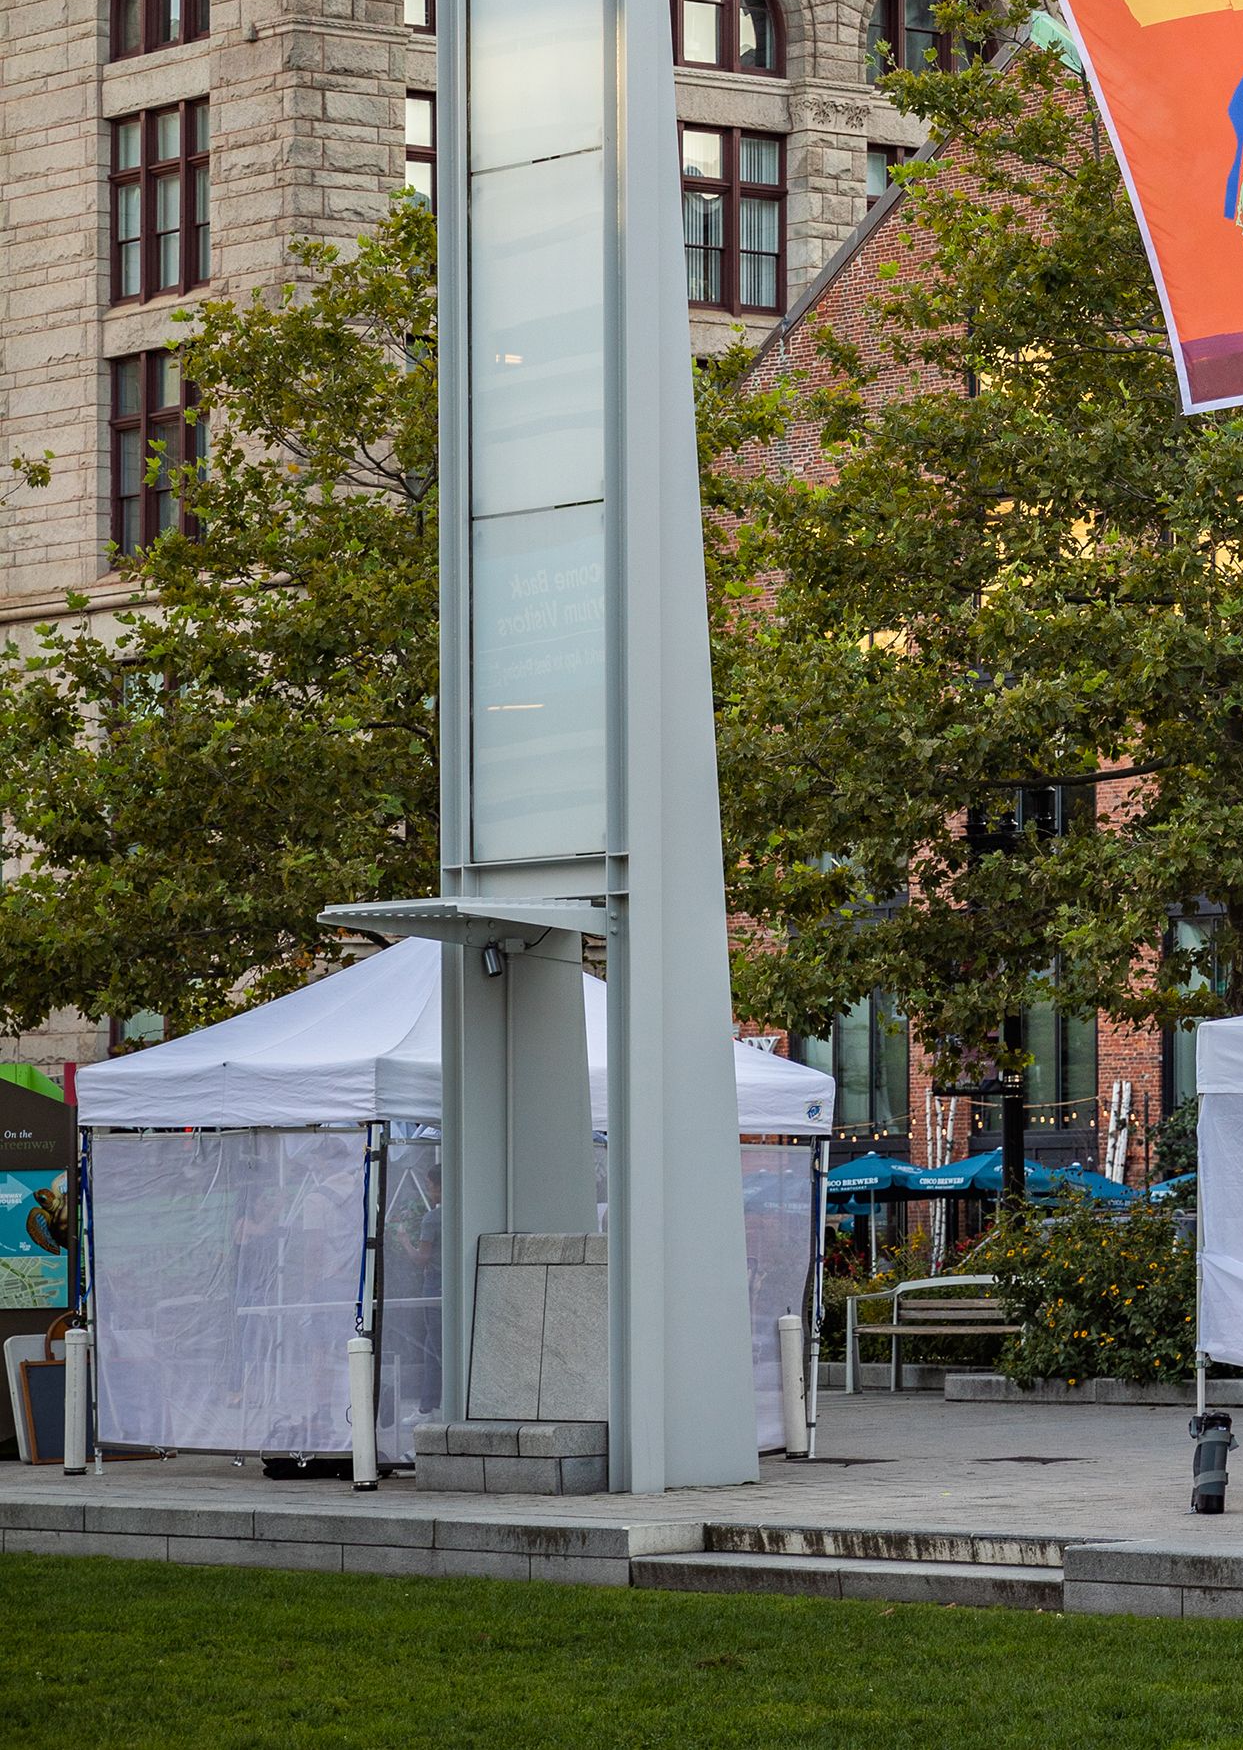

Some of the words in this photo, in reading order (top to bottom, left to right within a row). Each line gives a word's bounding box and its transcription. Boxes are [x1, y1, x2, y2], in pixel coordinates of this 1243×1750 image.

[4, 1130, 17, 1139] On
[19, 1129, 33, 1139] the
[842, 1177, 879, 1186] BREWERS
[919, 1177, 937, 1185] CISCO
[937, 1177, 964, 1185] BREWERS
